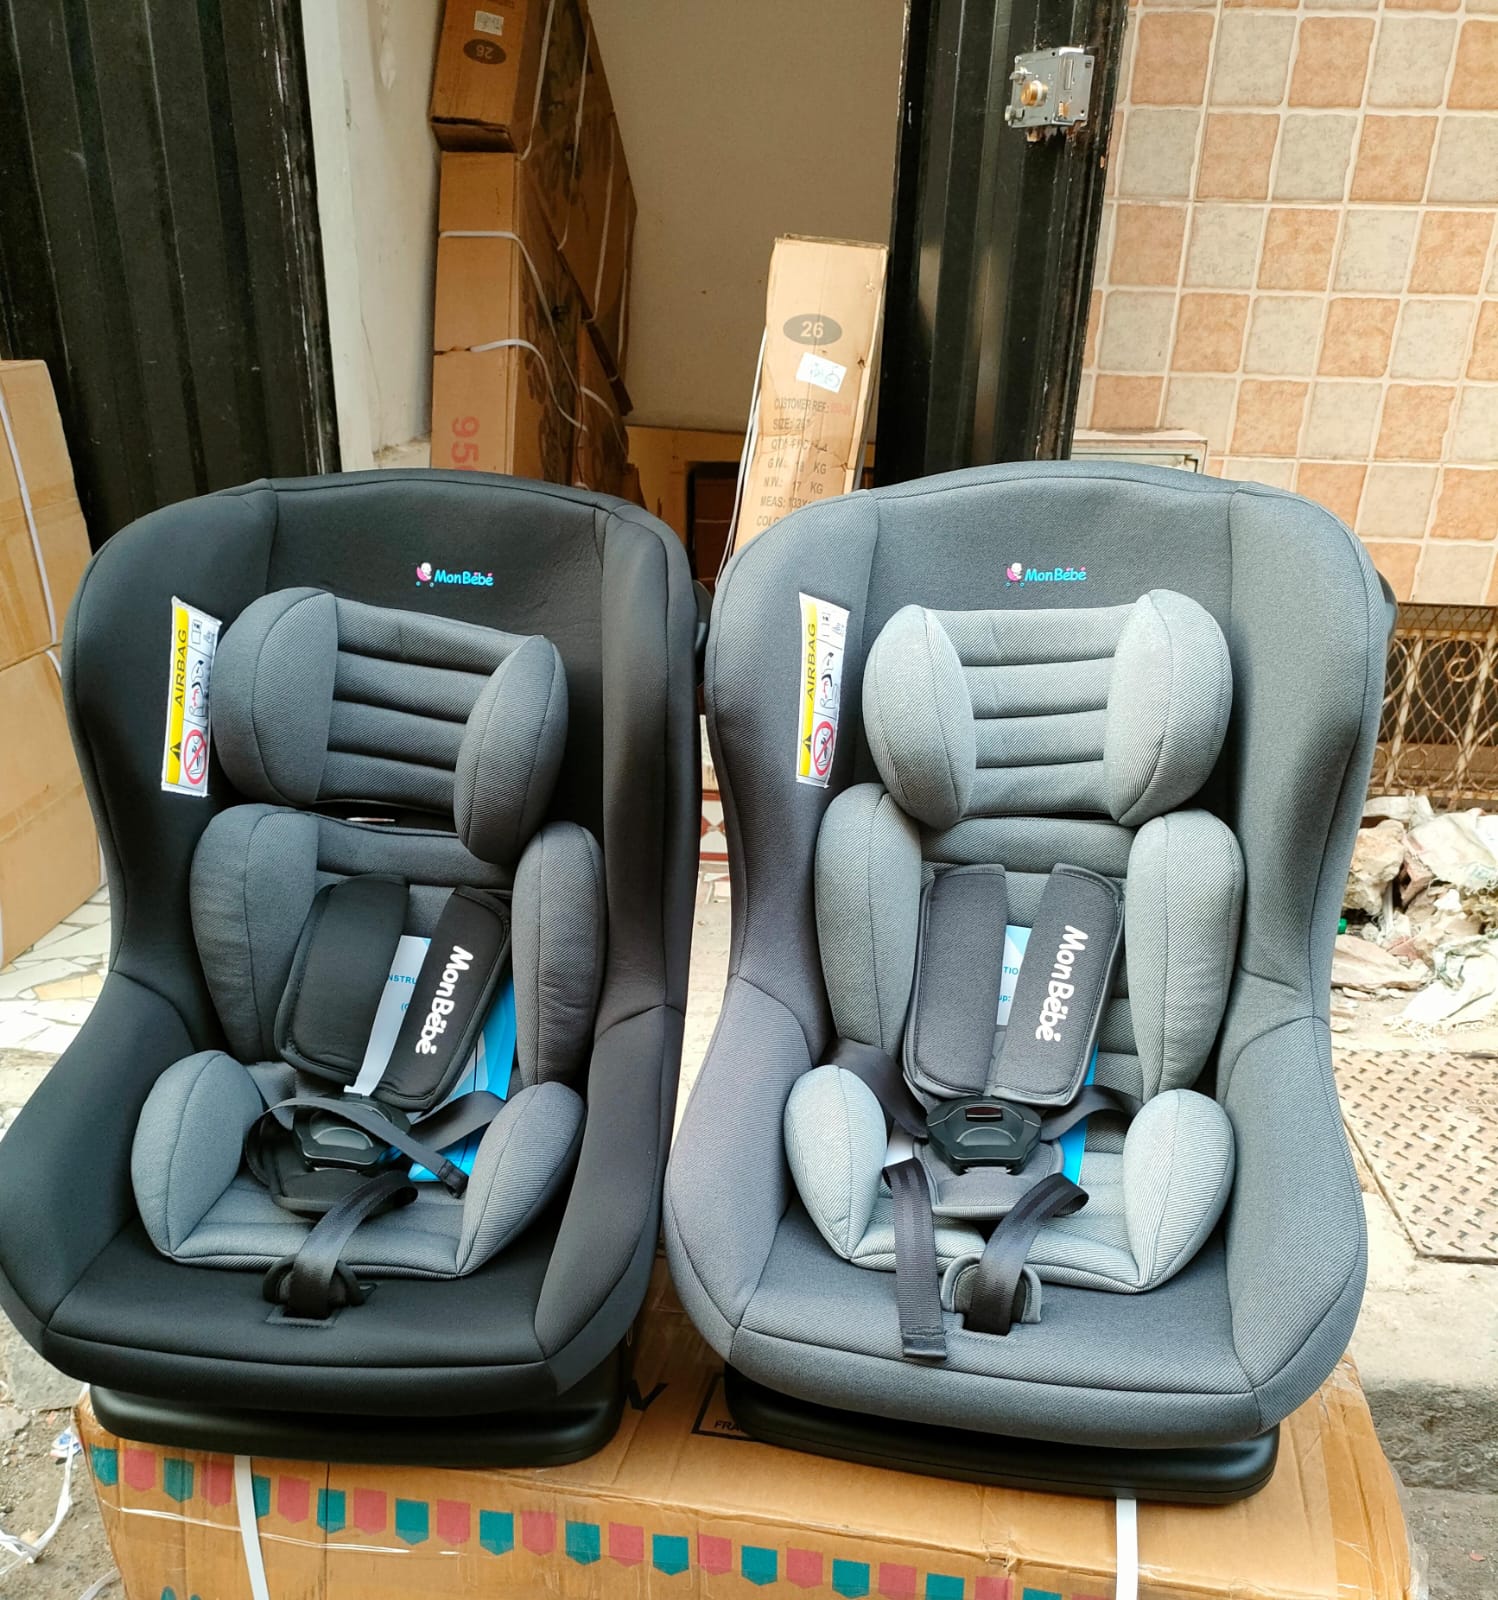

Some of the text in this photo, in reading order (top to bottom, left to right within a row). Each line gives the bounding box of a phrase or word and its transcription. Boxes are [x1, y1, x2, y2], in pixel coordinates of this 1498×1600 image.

[801, 320, 825, 338] 26
[451, 415, 481, 471] 95
[813, 461, 827, 475] KG
[809, 480, 824, 494] KG
[760, 495, 785, 509] MEAS:
[174, 629, 187, 706] AIRBAG
[806, 623, 816, 700] AIRBAG
